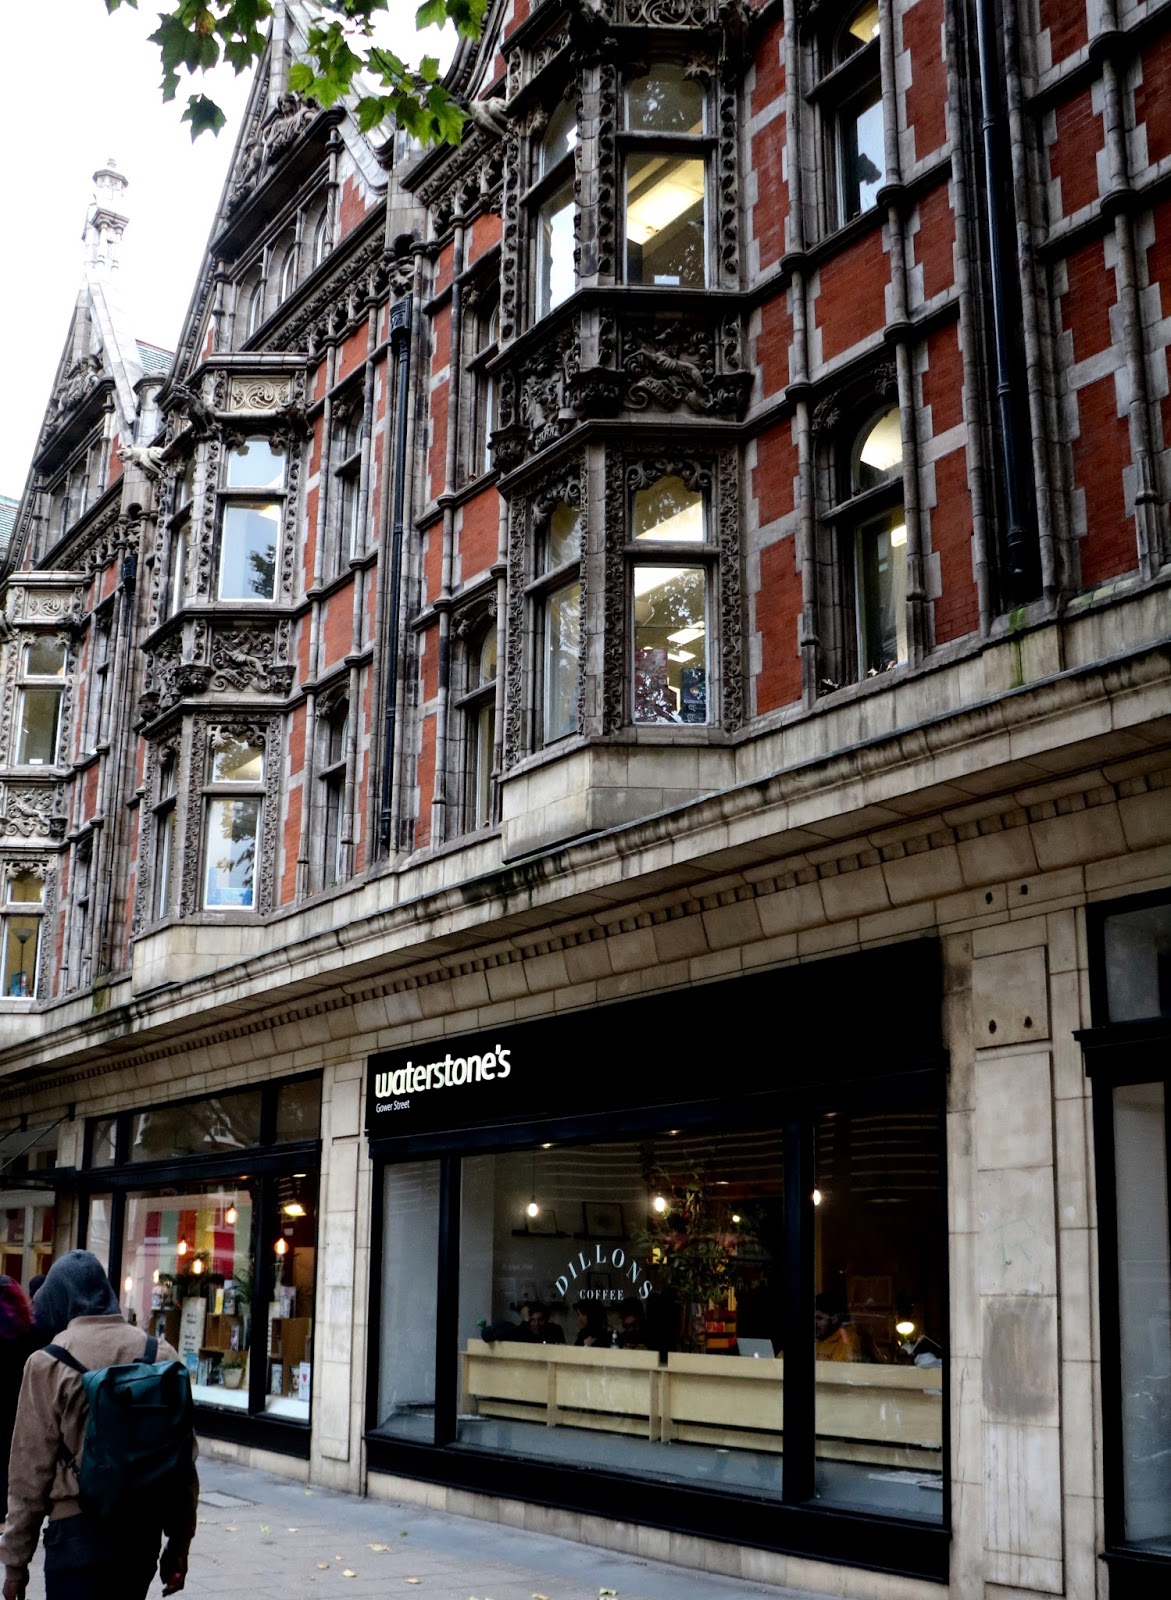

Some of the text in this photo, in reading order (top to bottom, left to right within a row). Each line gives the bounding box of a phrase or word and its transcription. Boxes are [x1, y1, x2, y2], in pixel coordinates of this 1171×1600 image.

[375, 1044, 511, 1098] waterstone's
[375, 1100, 410, 1113] Gower Street
[555, 1244, 653, 1299] DILLONS
[579, 1289, 624, 1301] COFFEE
